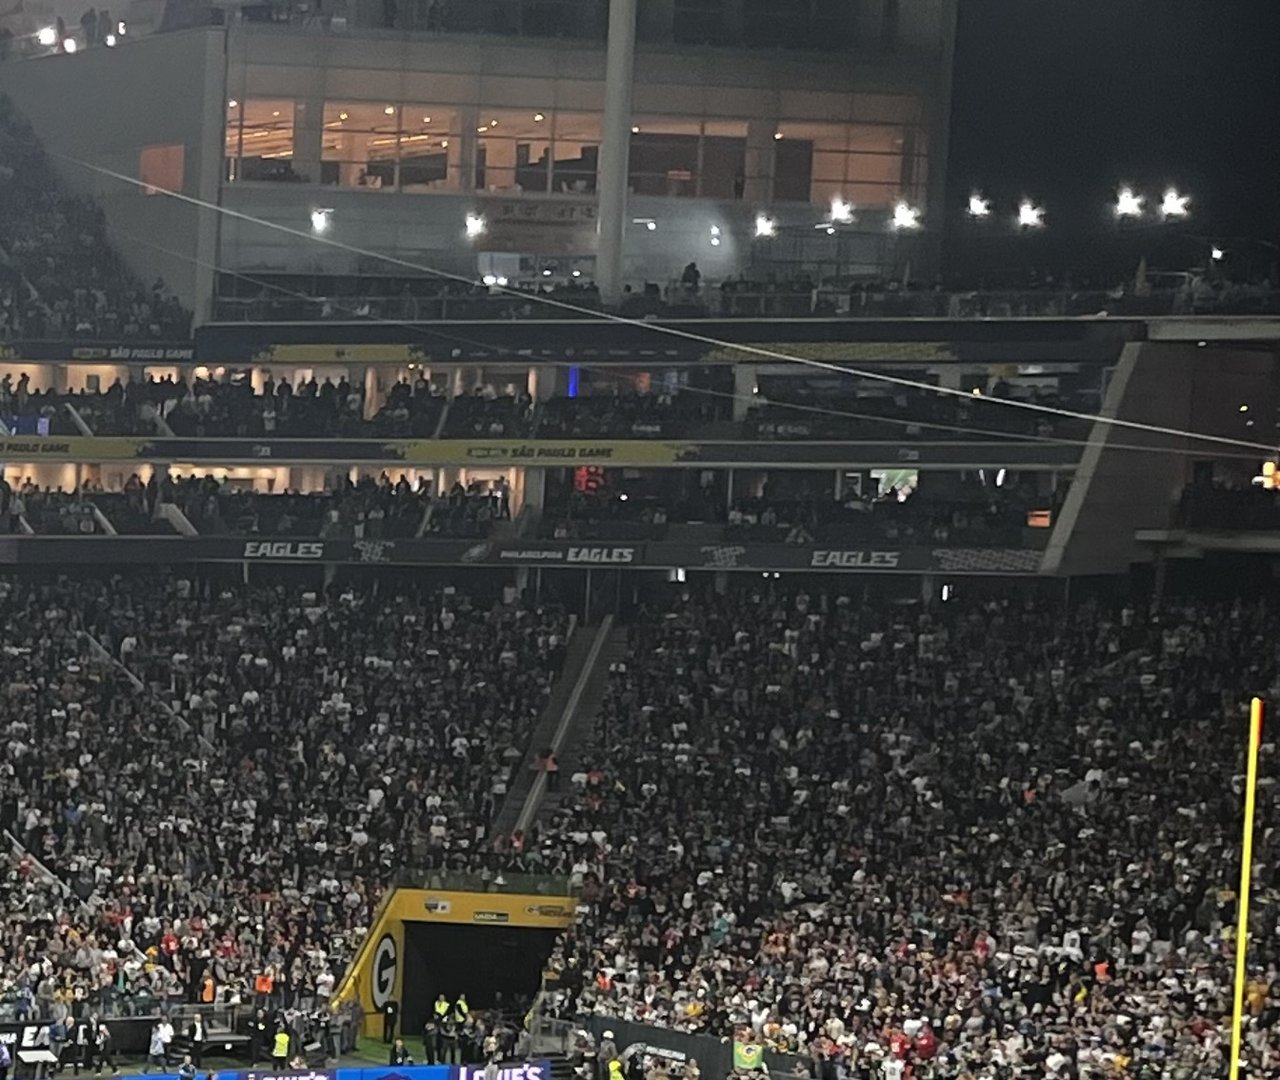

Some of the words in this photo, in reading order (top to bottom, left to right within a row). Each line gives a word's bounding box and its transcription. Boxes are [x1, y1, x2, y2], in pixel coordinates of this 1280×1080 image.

[244, 543, 324, 559] EAGLES
[567, 546, 634, 564] EAGLES
[811, 550, 899, 568] EAGLES
